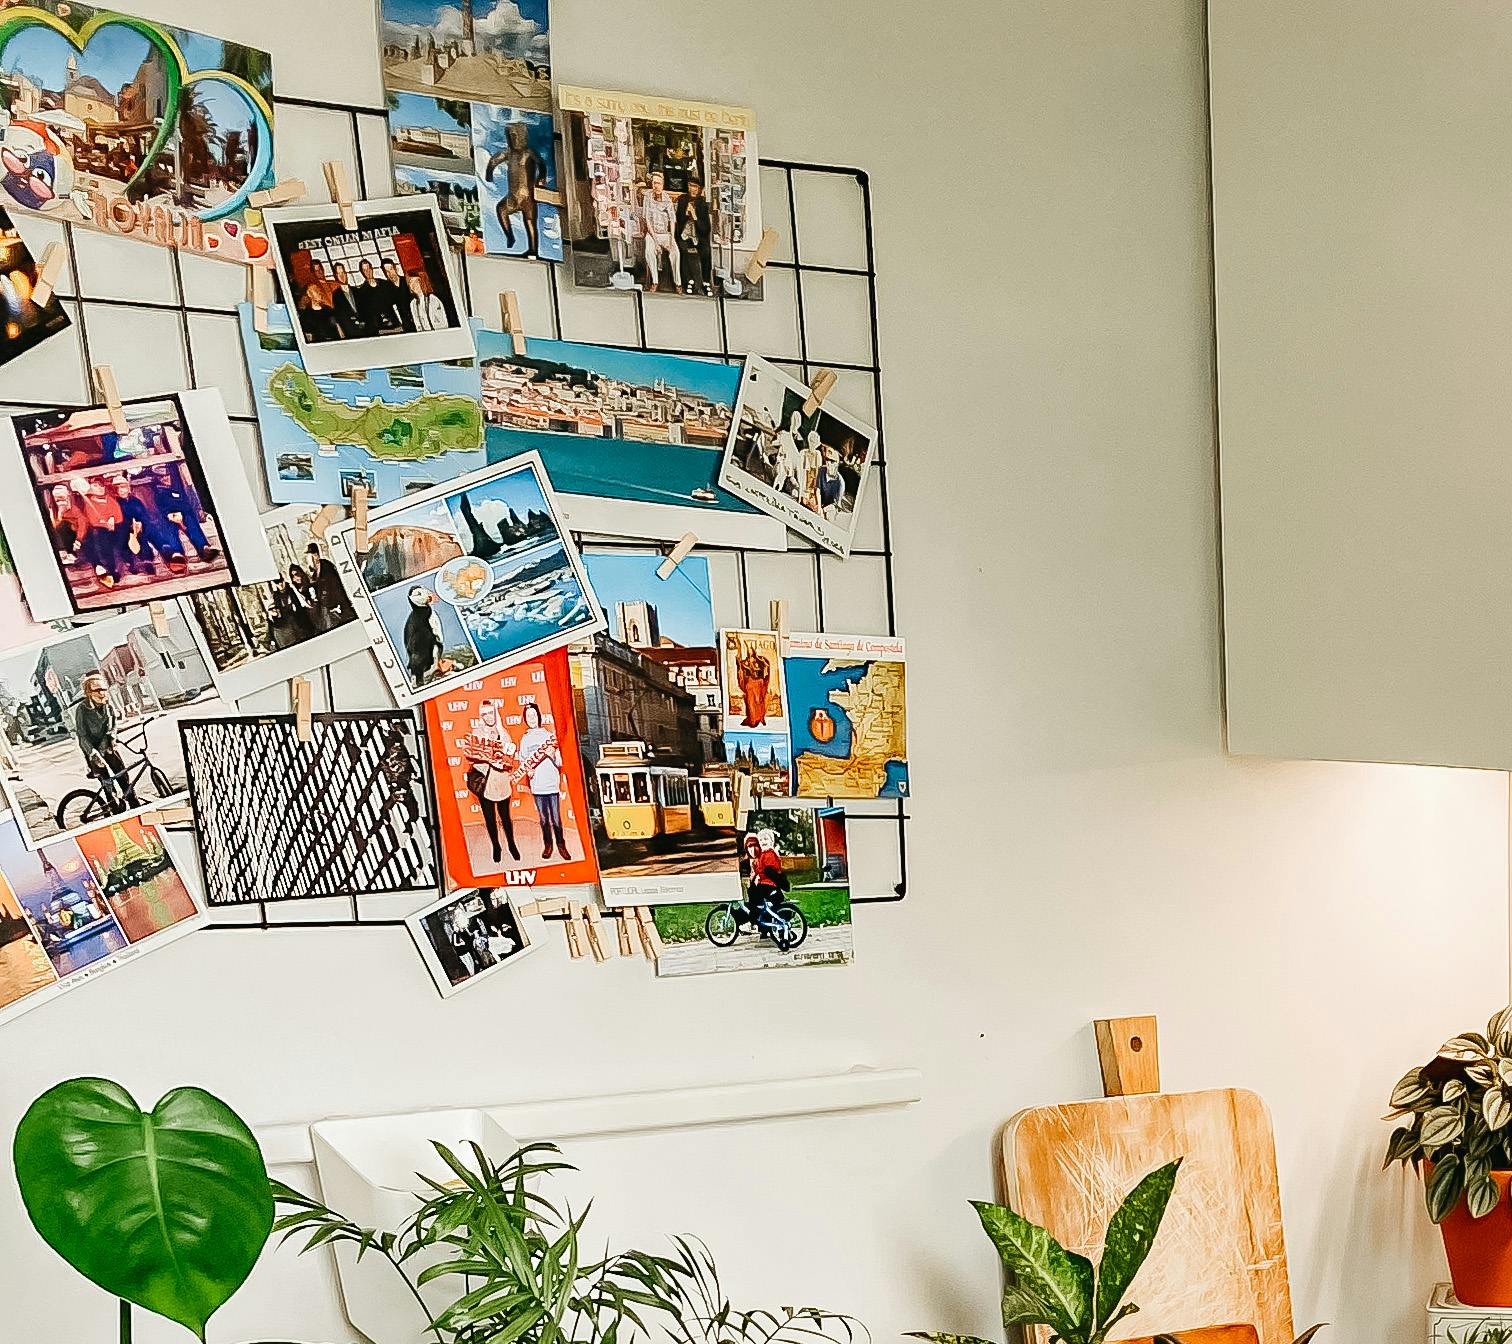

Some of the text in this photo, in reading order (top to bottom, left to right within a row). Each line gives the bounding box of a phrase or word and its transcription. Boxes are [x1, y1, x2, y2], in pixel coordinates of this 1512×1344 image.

[361, 225, 400, 241] MAFIA
[330, 535, 405, 689] ICELAND
[726, 632, 777, 652] SNTIAGO
[505, 870, 537, 885] LHV
